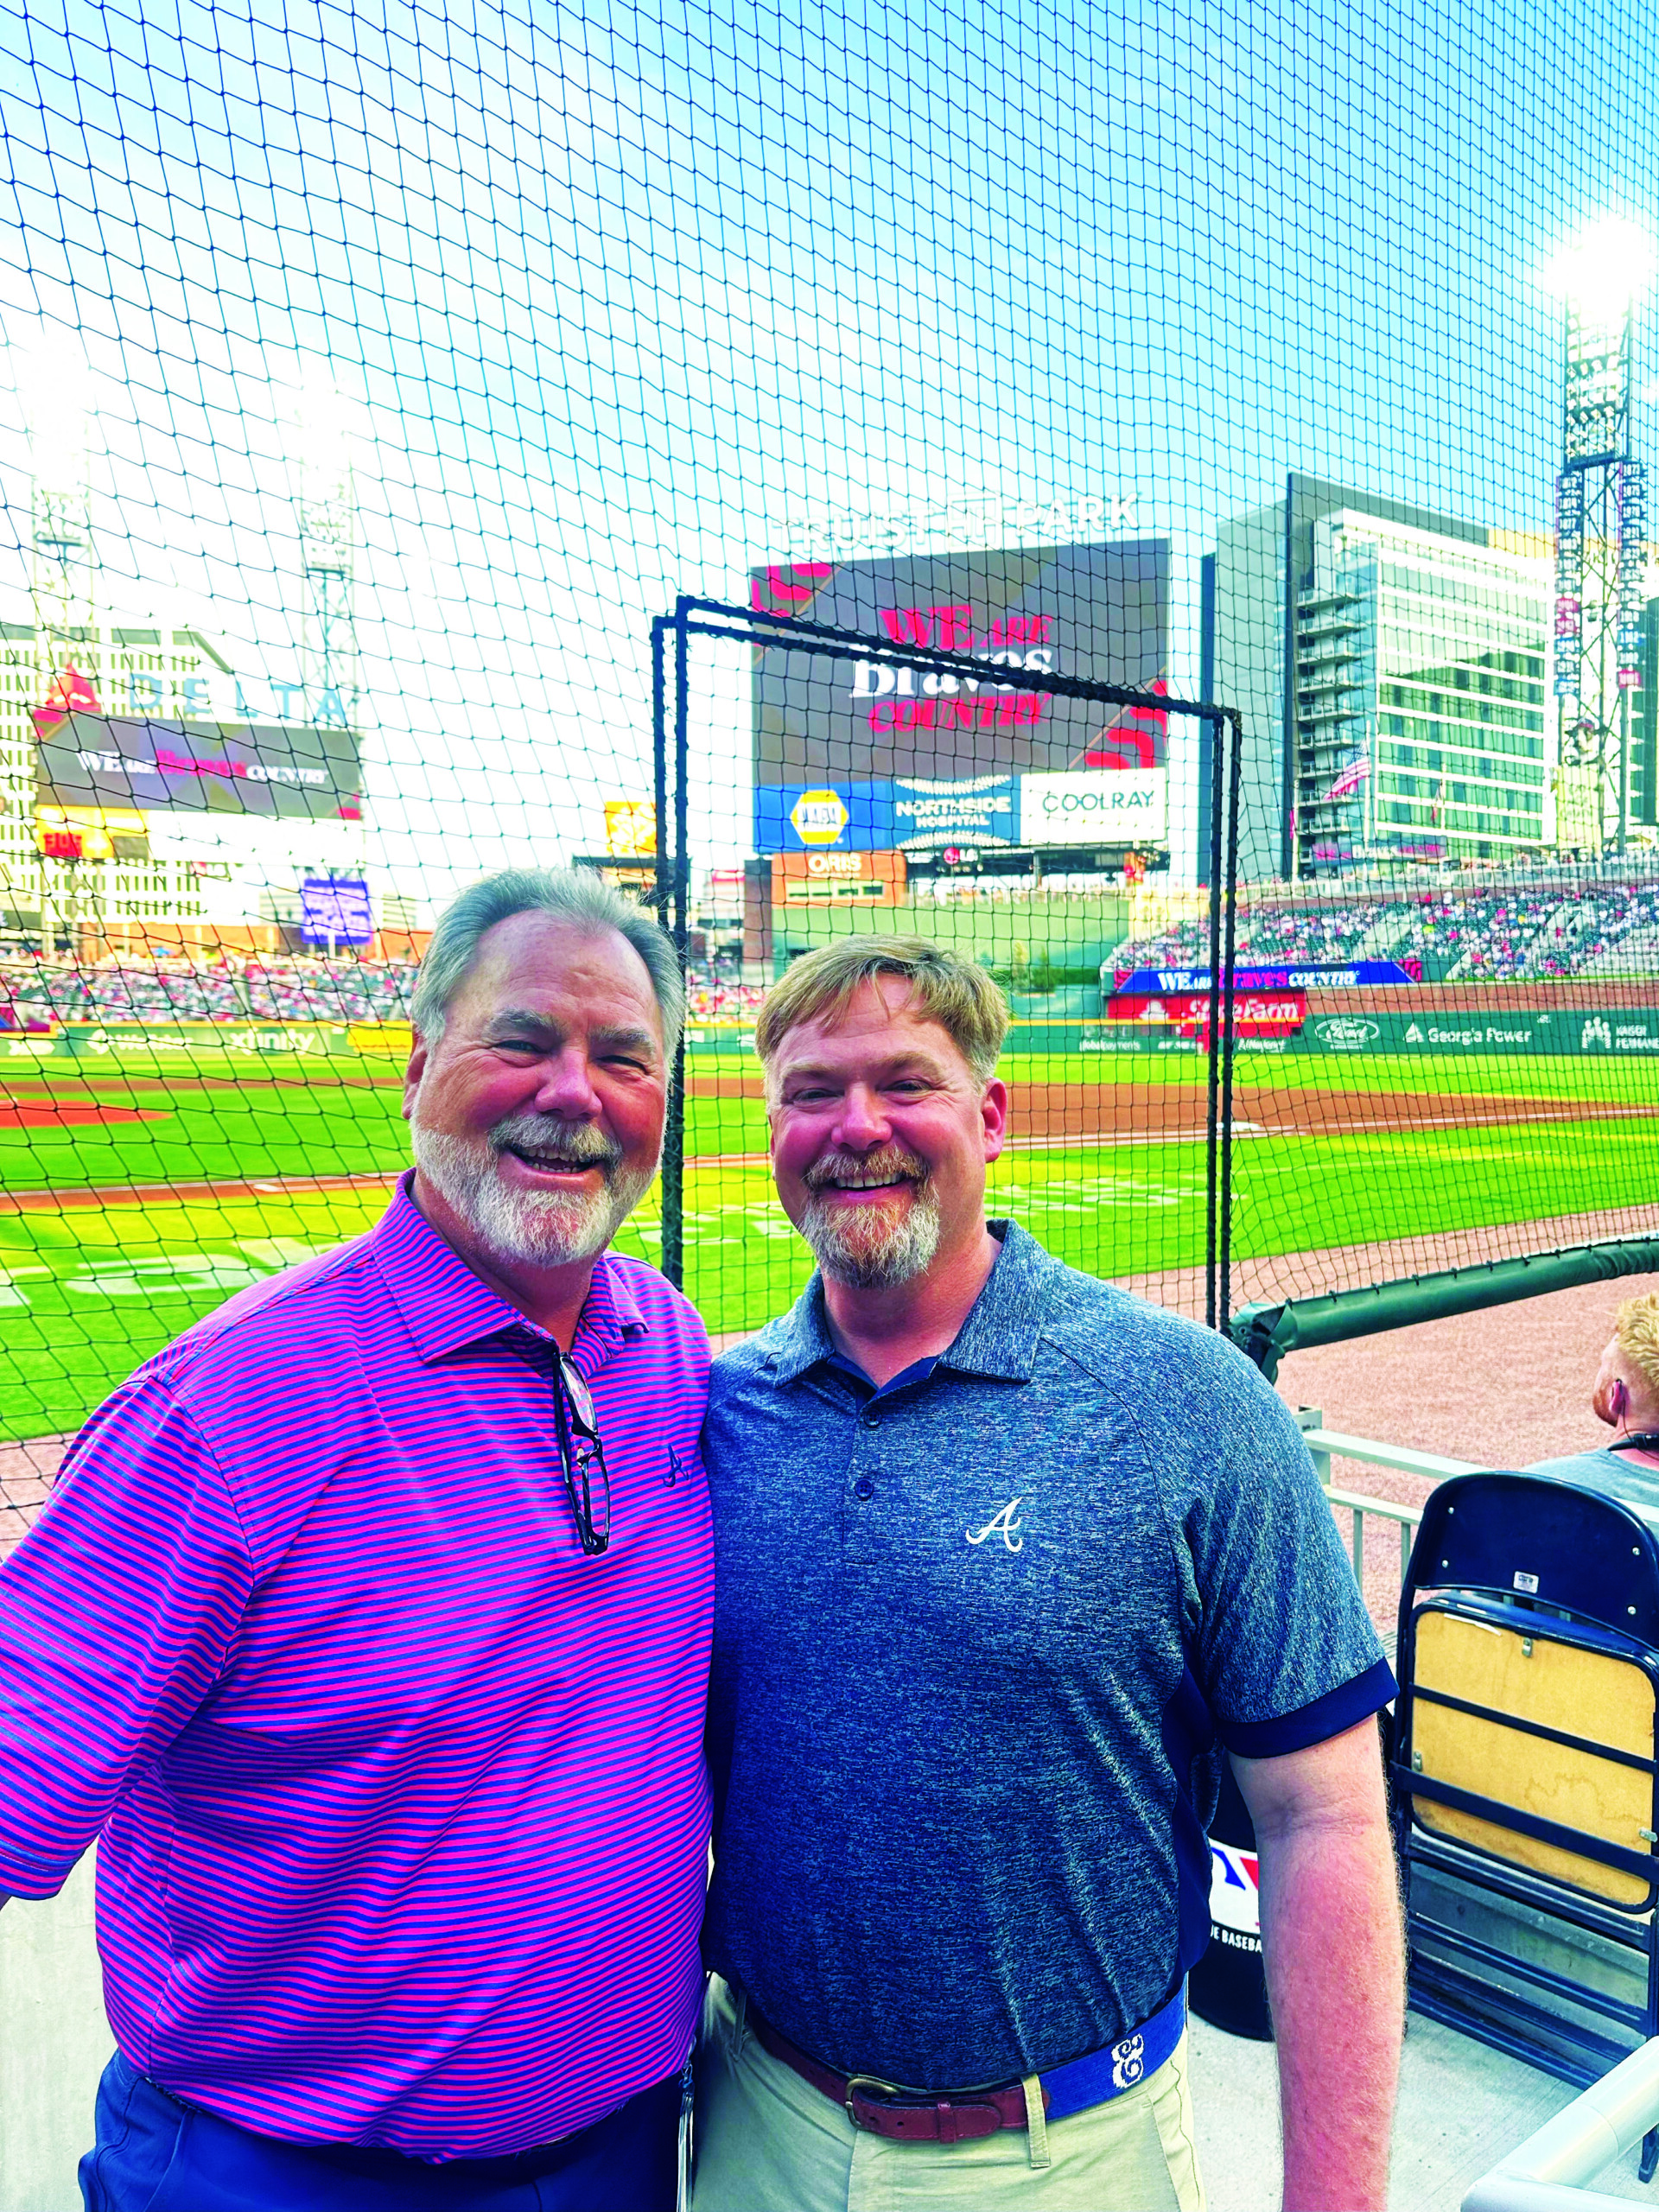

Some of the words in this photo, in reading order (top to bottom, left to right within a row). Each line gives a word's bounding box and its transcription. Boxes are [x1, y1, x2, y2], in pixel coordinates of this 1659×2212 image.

[1014, 491, 1141, 539] PARK
[878, 604, 976, 650] WE
[978, 614, 1054, 648] ARE
[129, 673, 348, 728] DELTA
[867, 692, 1053, 734] COUNTRY
[75, 750, 121, 772] WE
[895, 796, 1012, 817] NORTHSIDE
[1041, 790, 1155, 813] COOLRAY
[916, 813, 990, 829] HOSPITAL
[808, 853, 862, 874] ORIS
[1157, 971, 1192, 991] WE
[1325, 1018, 1369, 1039] Ford
[1427, 1027, 1484, 1046] Georgia
[1485, 1027, 1533, 1044] Power
[228, 1027, 315, 1056] xfinity
[966, 1497, 1024, 1553] A
